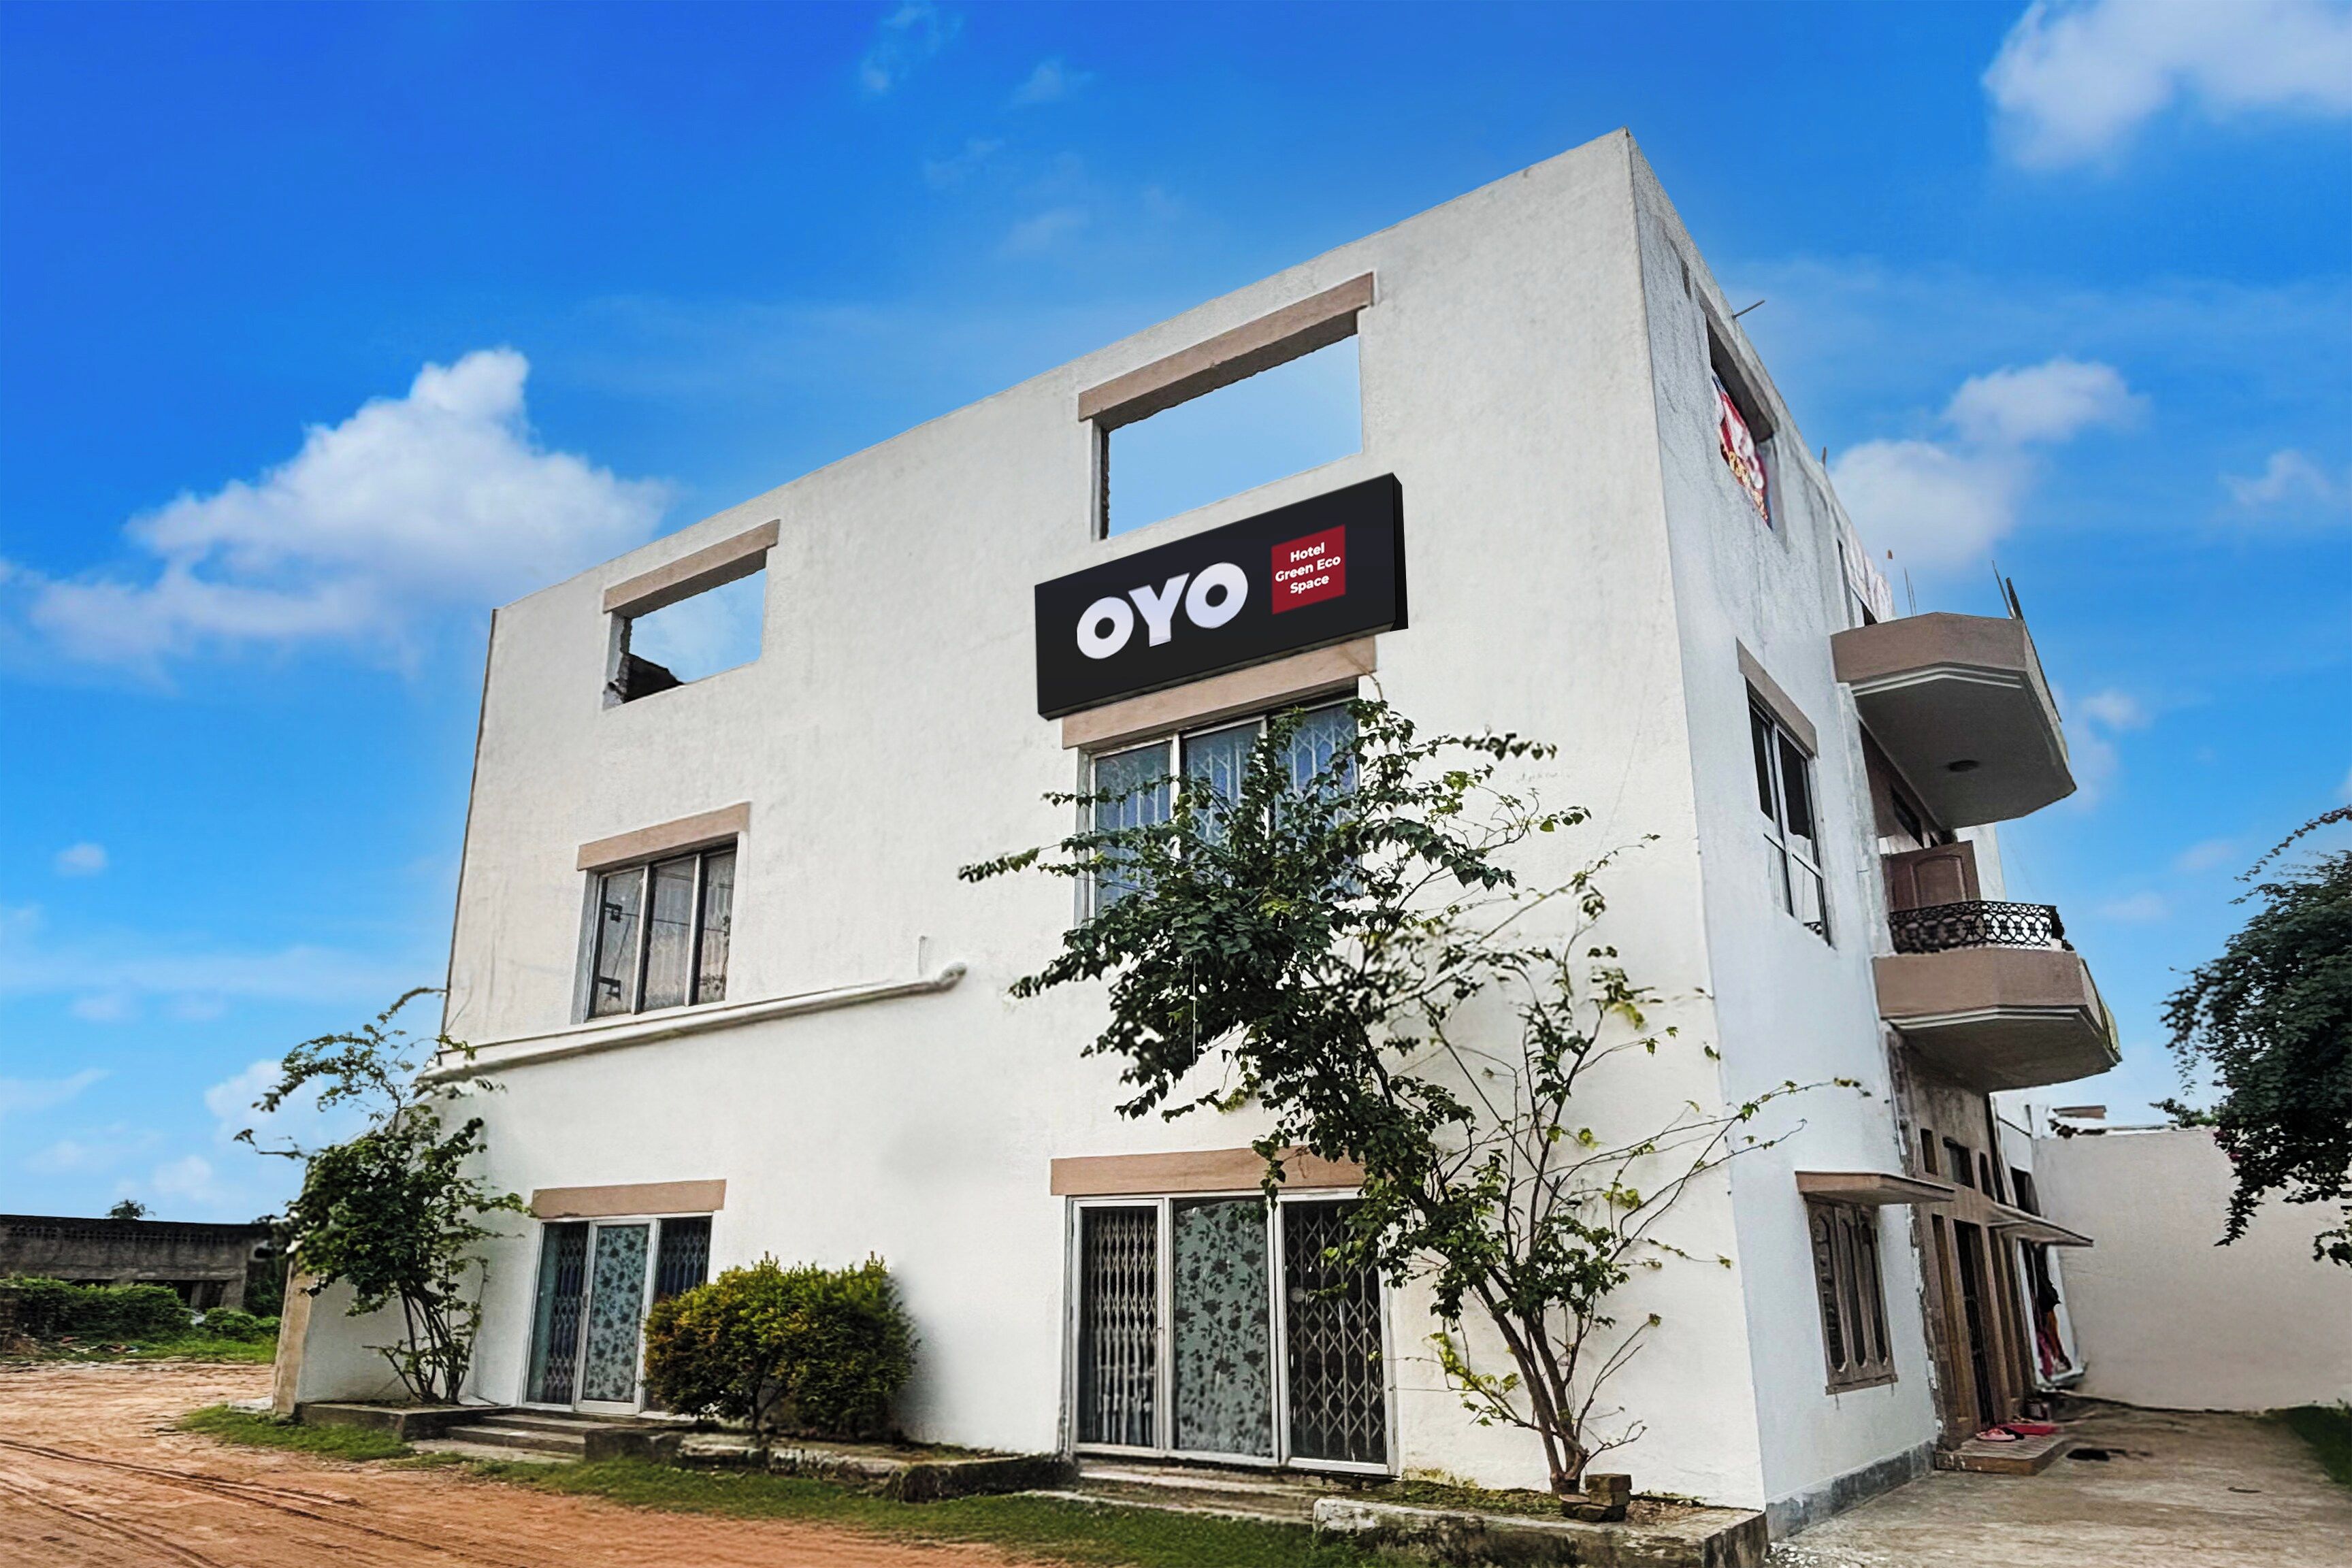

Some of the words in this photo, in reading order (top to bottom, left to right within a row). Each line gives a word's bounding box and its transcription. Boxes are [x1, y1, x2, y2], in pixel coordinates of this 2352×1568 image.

[1290, 542, 1325, 563] Hotel
[1275, 564, 1313, 582] Green
[1317, 556, 1341, 570] Eco
[1290, 575, 1330, 594] Space
[1077, 562, 1248, 659] OYO
